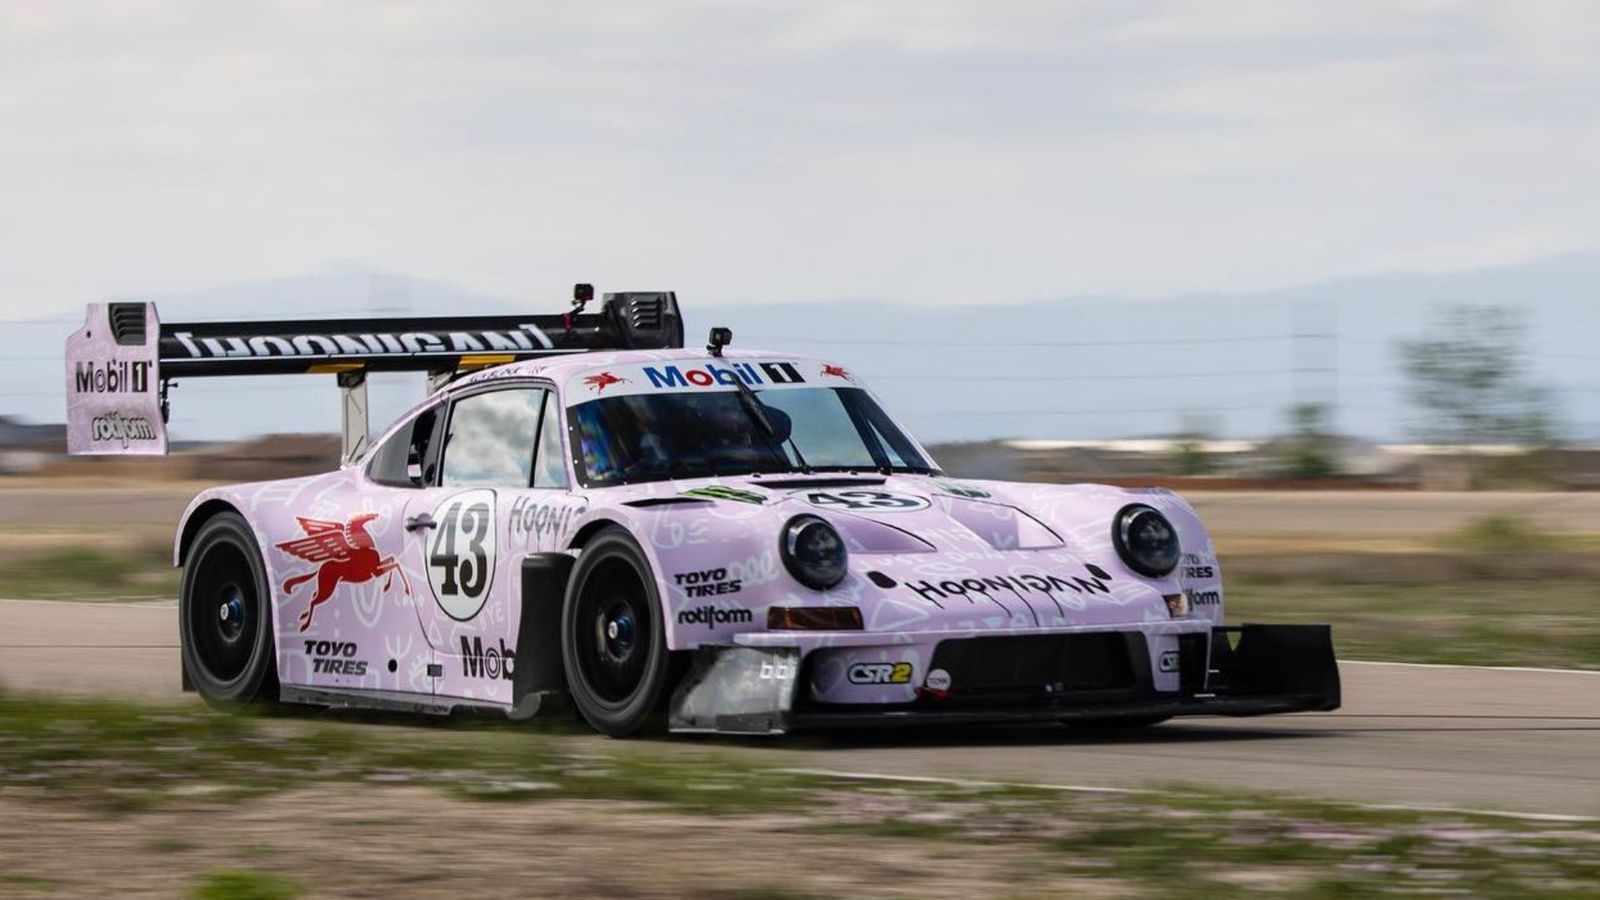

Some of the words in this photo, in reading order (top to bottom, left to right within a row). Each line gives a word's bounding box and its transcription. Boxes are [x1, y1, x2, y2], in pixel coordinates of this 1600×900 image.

[76, 360, 128, 393] Mobil
[134, 361, 147, 393] 1
[643, 362, 763, 388] Mobil
[763, 362, 802, 384] 1
[808, 491, 919, 509] 43
[508, 495, 587, 541] HOONI
[430, 502, 490, 598] 43
[674, 568, 727, 585] TOYO
[685, 580, 742, 598] TIRES
[678, 605, 752, 629] rotiform
[304, 640, 358, 657] TOYO
[460, 635, 516, 681] Mob
[312, 657, 369, 676] TIRES
[849, 662, 912, 685] CSR2
